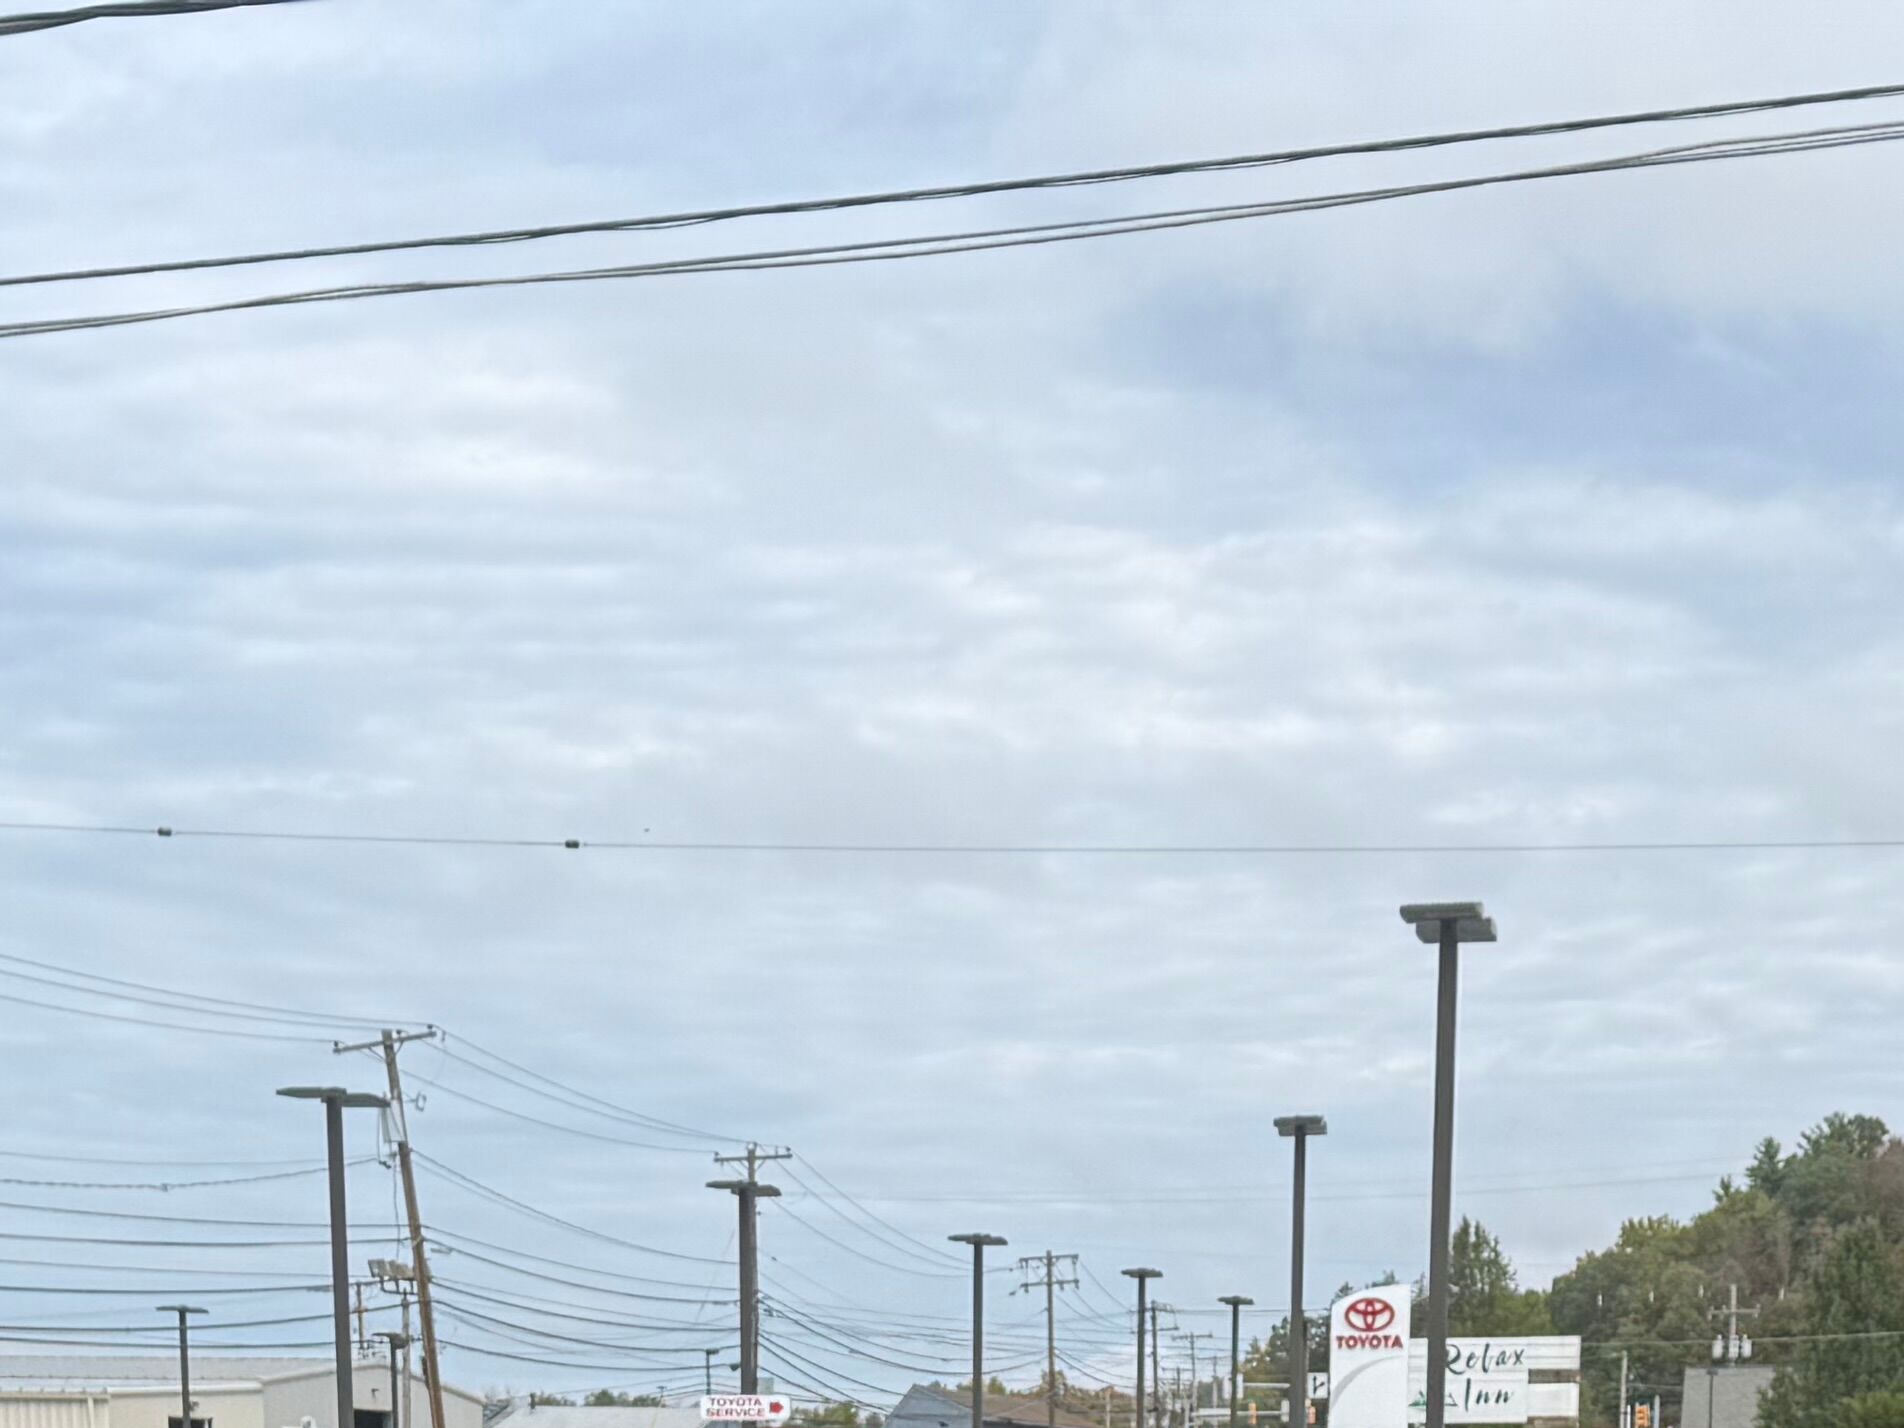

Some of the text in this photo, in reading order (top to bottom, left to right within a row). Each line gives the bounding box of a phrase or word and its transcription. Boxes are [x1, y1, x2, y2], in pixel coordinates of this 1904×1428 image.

[1336, 1334, 1403, 1349] TOYOTA
[1446, 1342, 1525, 1375] Relax
[709, 1397, 762, 1407] TOYOTA
[1465, 1378, 1514, 1412] Inn
[706, 1408, 765, 1417] SERVICE
